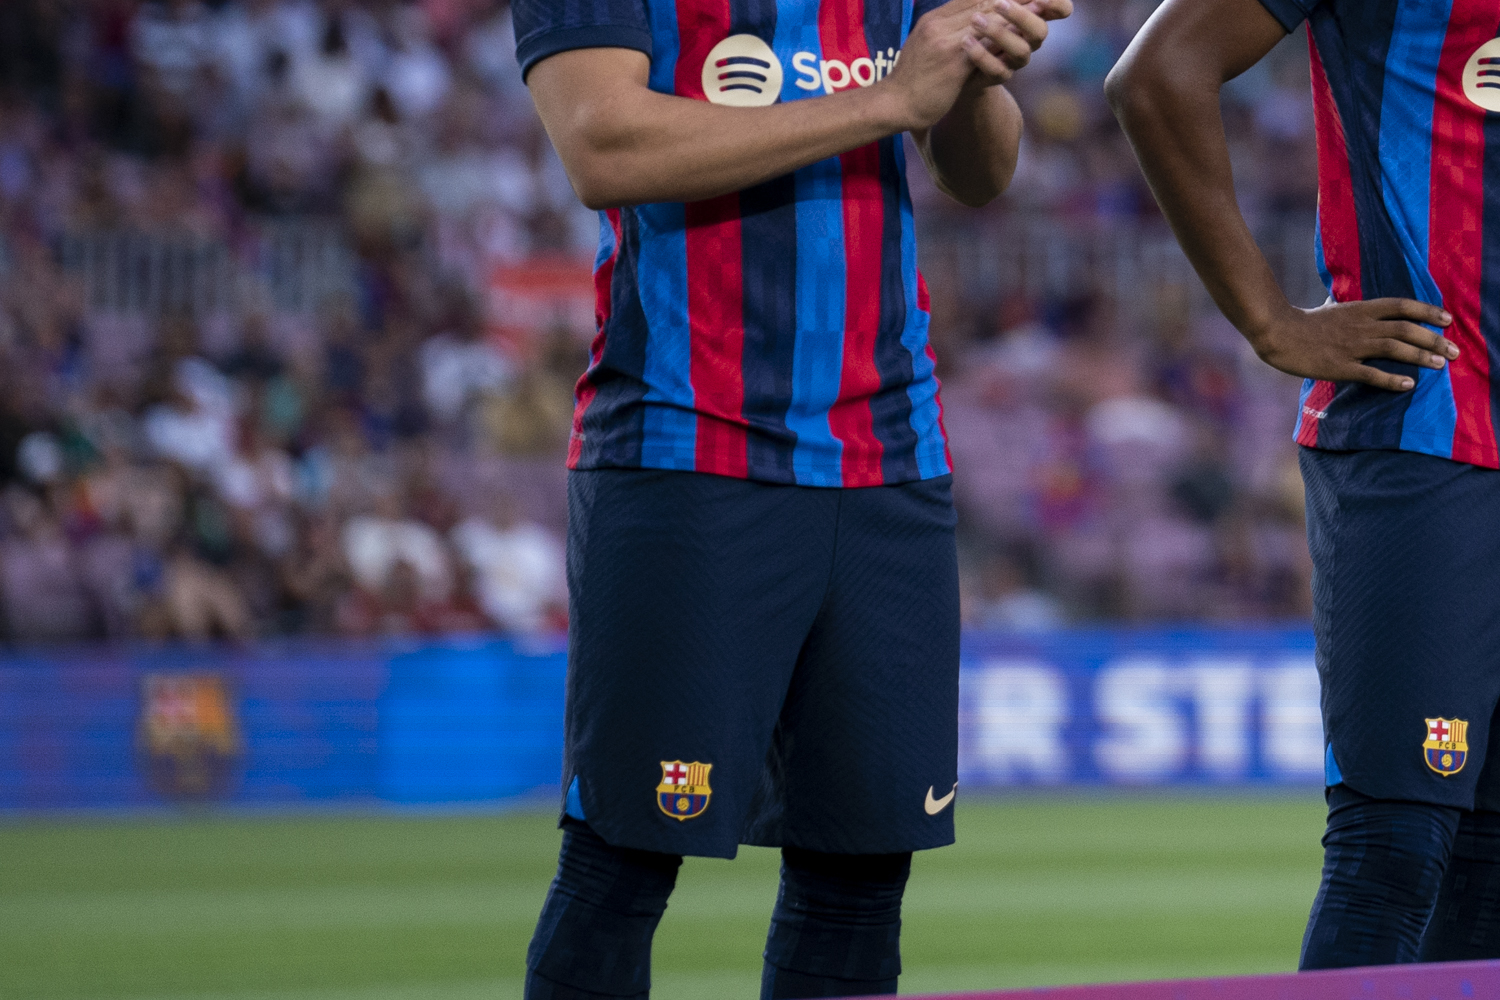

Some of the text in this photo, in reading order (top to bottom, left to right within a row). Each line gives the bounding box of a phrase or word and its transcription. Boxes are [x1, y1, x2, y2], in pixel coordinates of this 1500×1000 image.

[792, 46, 901, 95] Spoti
[1438, 741, 1457, 750] FCB
[673, 785, 695, 793] FCB
